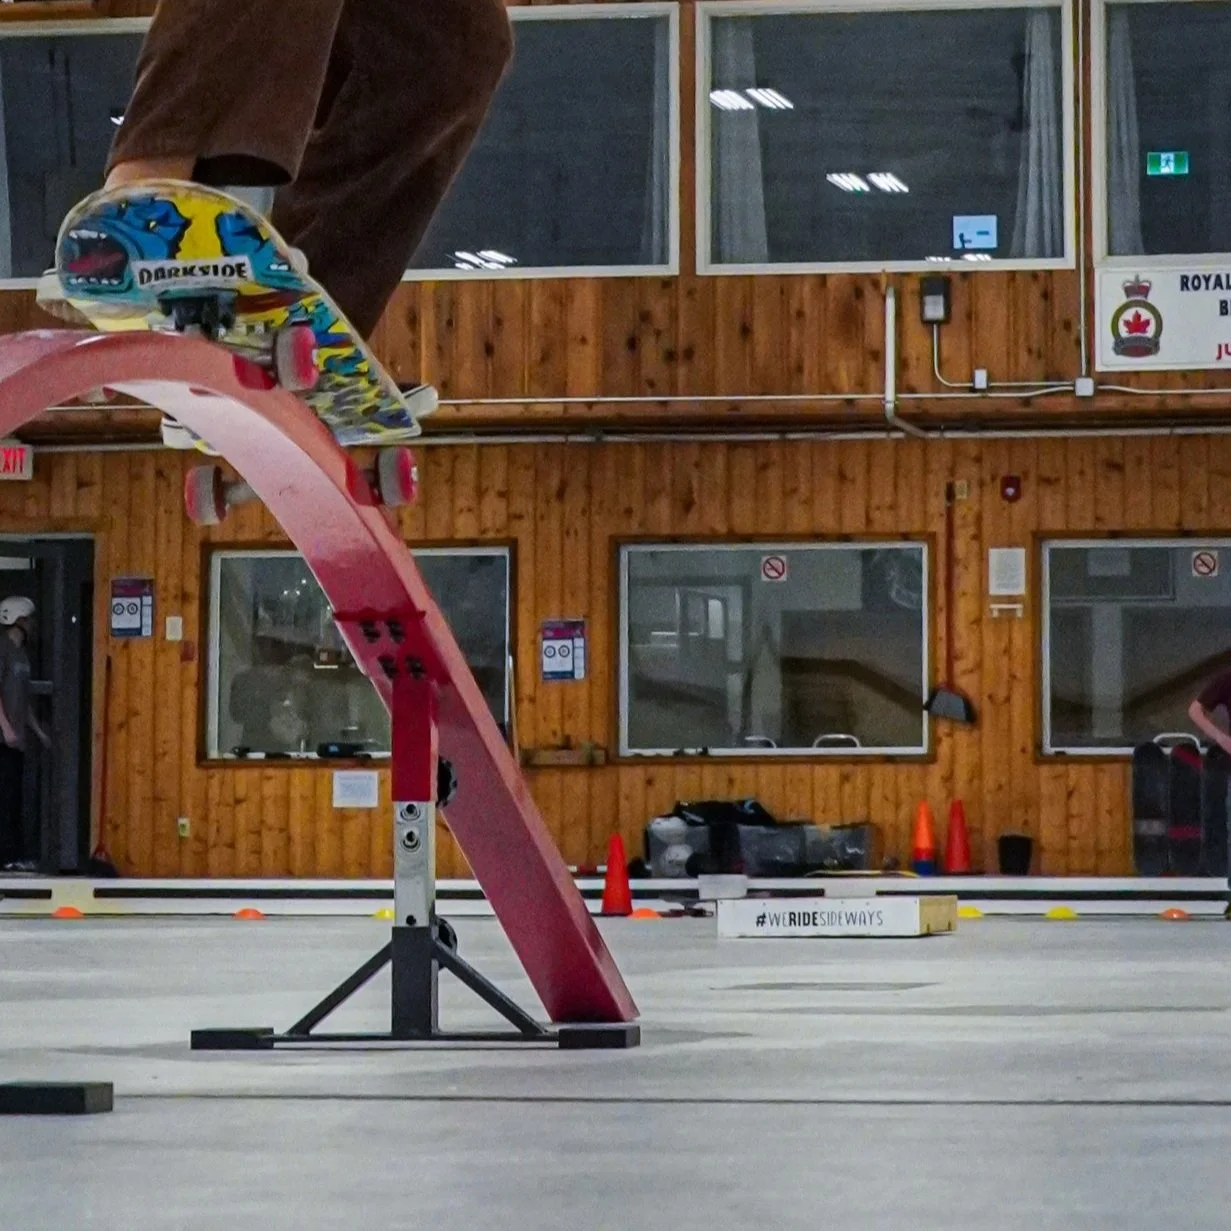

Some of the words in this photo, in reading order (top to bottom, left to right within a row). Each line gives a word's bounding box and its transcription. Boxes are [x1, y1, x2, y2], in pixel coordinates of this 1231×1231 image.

[139, 262, 247, 285] DARKSIDE
[1180, 273, 1231, 292] ROYAL
[1219, 299, 1231, 317] B
[756, 910, 884, 928] #WERIDESIDEWAYS
